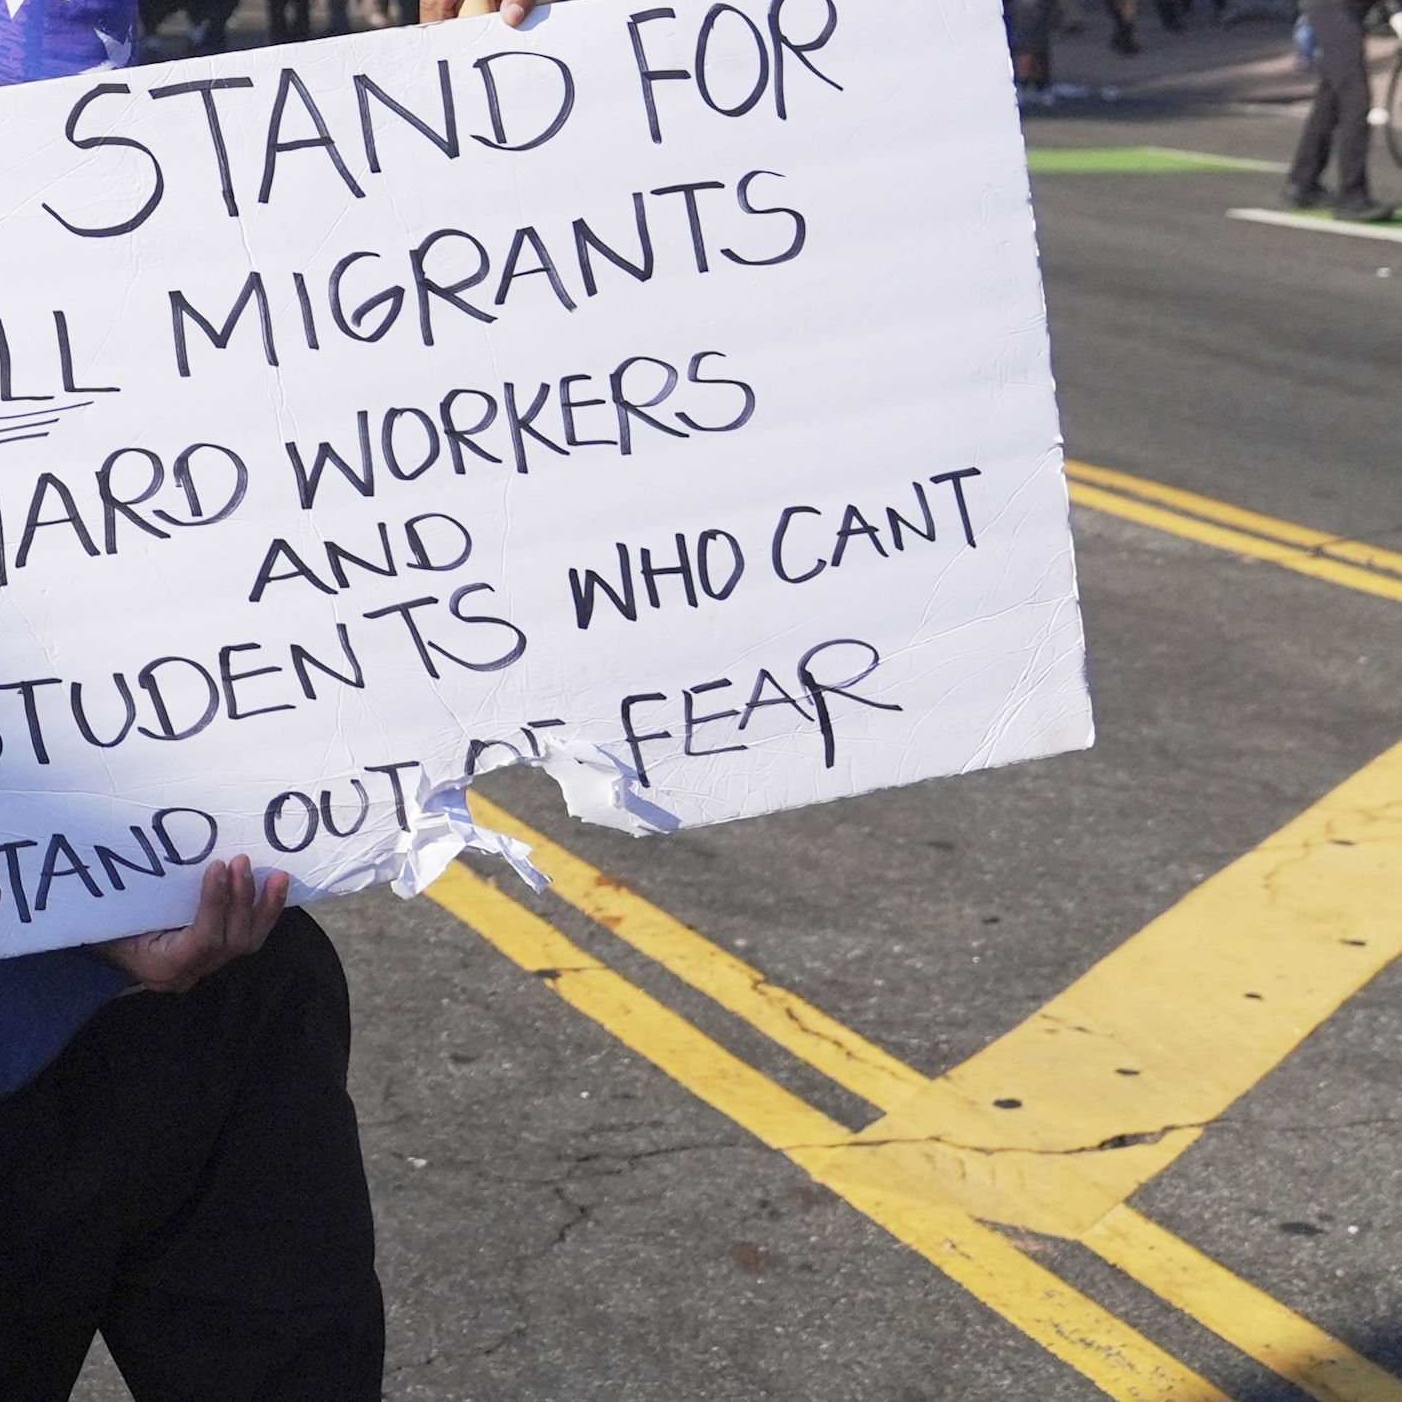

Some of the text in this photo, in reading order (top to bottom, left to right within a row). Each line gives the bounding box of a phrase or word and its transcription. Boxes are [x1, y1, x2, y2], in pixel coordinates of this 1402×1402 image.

[42, 50, 576, 238] STAND
[167, 169, 806, 378] MIGRANTS
[285, 351, 756, 510] WORKERS
[248, 512, 473, 603] AND
[569, 529, 745, 630] WHO
[772, 466, 982, 585] CANT
[264, 761, 420, 854] OUT
[621, 638, 904, 788] FEAR
